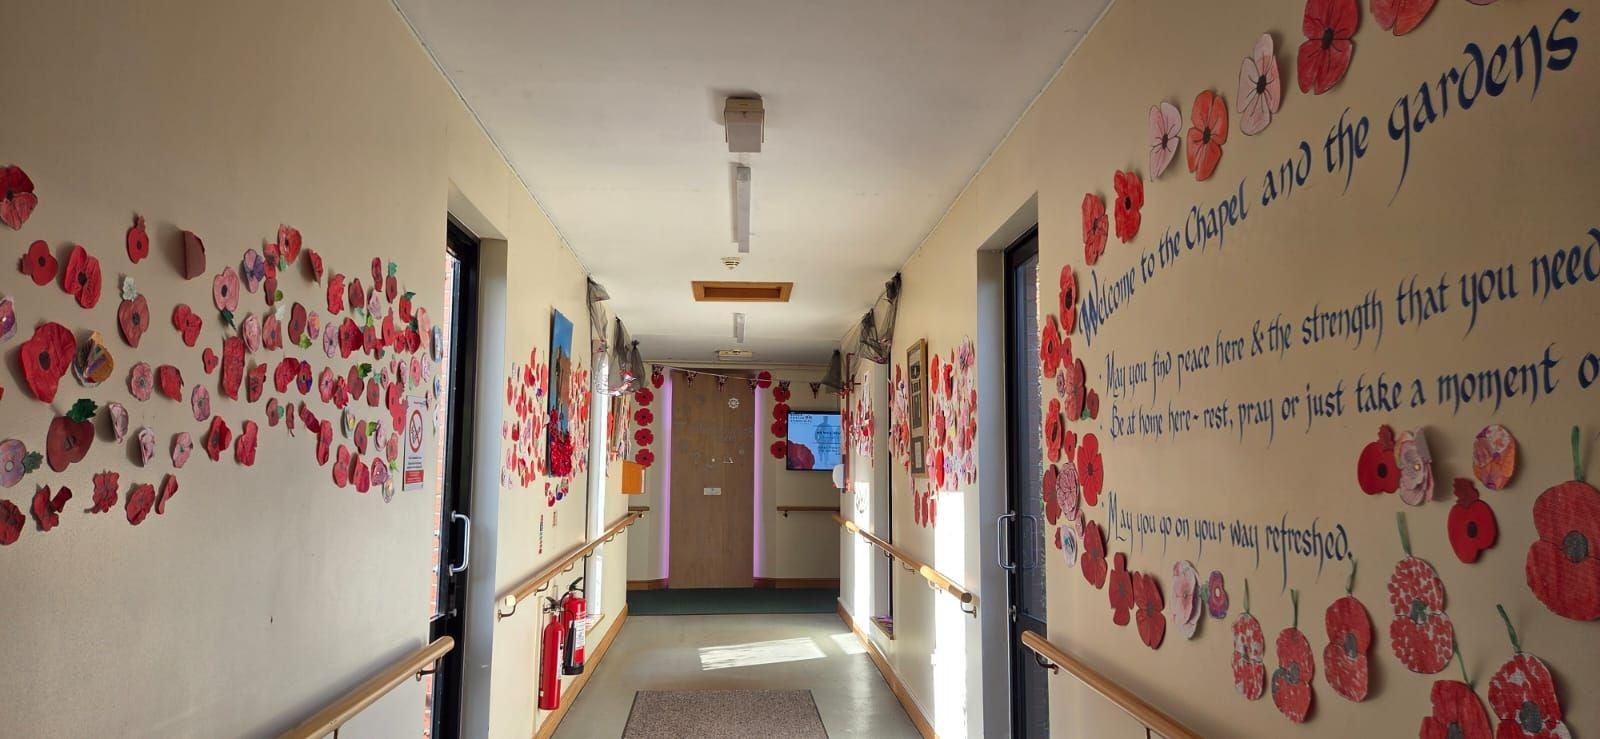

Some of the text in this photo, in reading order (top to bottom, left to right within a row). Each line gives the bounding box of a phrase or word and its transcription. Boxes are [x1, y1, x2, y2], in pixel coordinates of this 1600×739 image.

[1079, 8, 1581, 347] Welcome to the Chapel and the gardens
[1105, 350, 1126, 400] May
[1129, 360, 1148, 397] you
[1151, 350, 1172, 409] find
[1177, 344, 1210, 393] peace
[1216, 329, 1245, 369] here
[1250, 319, 1265, 358] &
[1267, 313, 1292, 360] the
[1301, 288, 1384, 352] strength
[1395, 271, 1450, 329] that
[1458, 263, 1519, 341] you
[1110, 400, 1124, 442] Be
[1126, 407, 1136, 436] at
[1139, 403, 1163, 442] home
[1203, 399, 1233, 431] rest,
[1238, 397, 1276, 449] pray
[1281, 394, 1300, 421] or
[1304, 378, 1348, 434] just
[1355, 371, 1403, 413] take
[1410, 378, 1428, 409] a
[1436, 342, 1564, 416] moment
[1577, 352, 1600, 389] o
[1106, 490, 1353, 590] May you go on your way refreshed.
